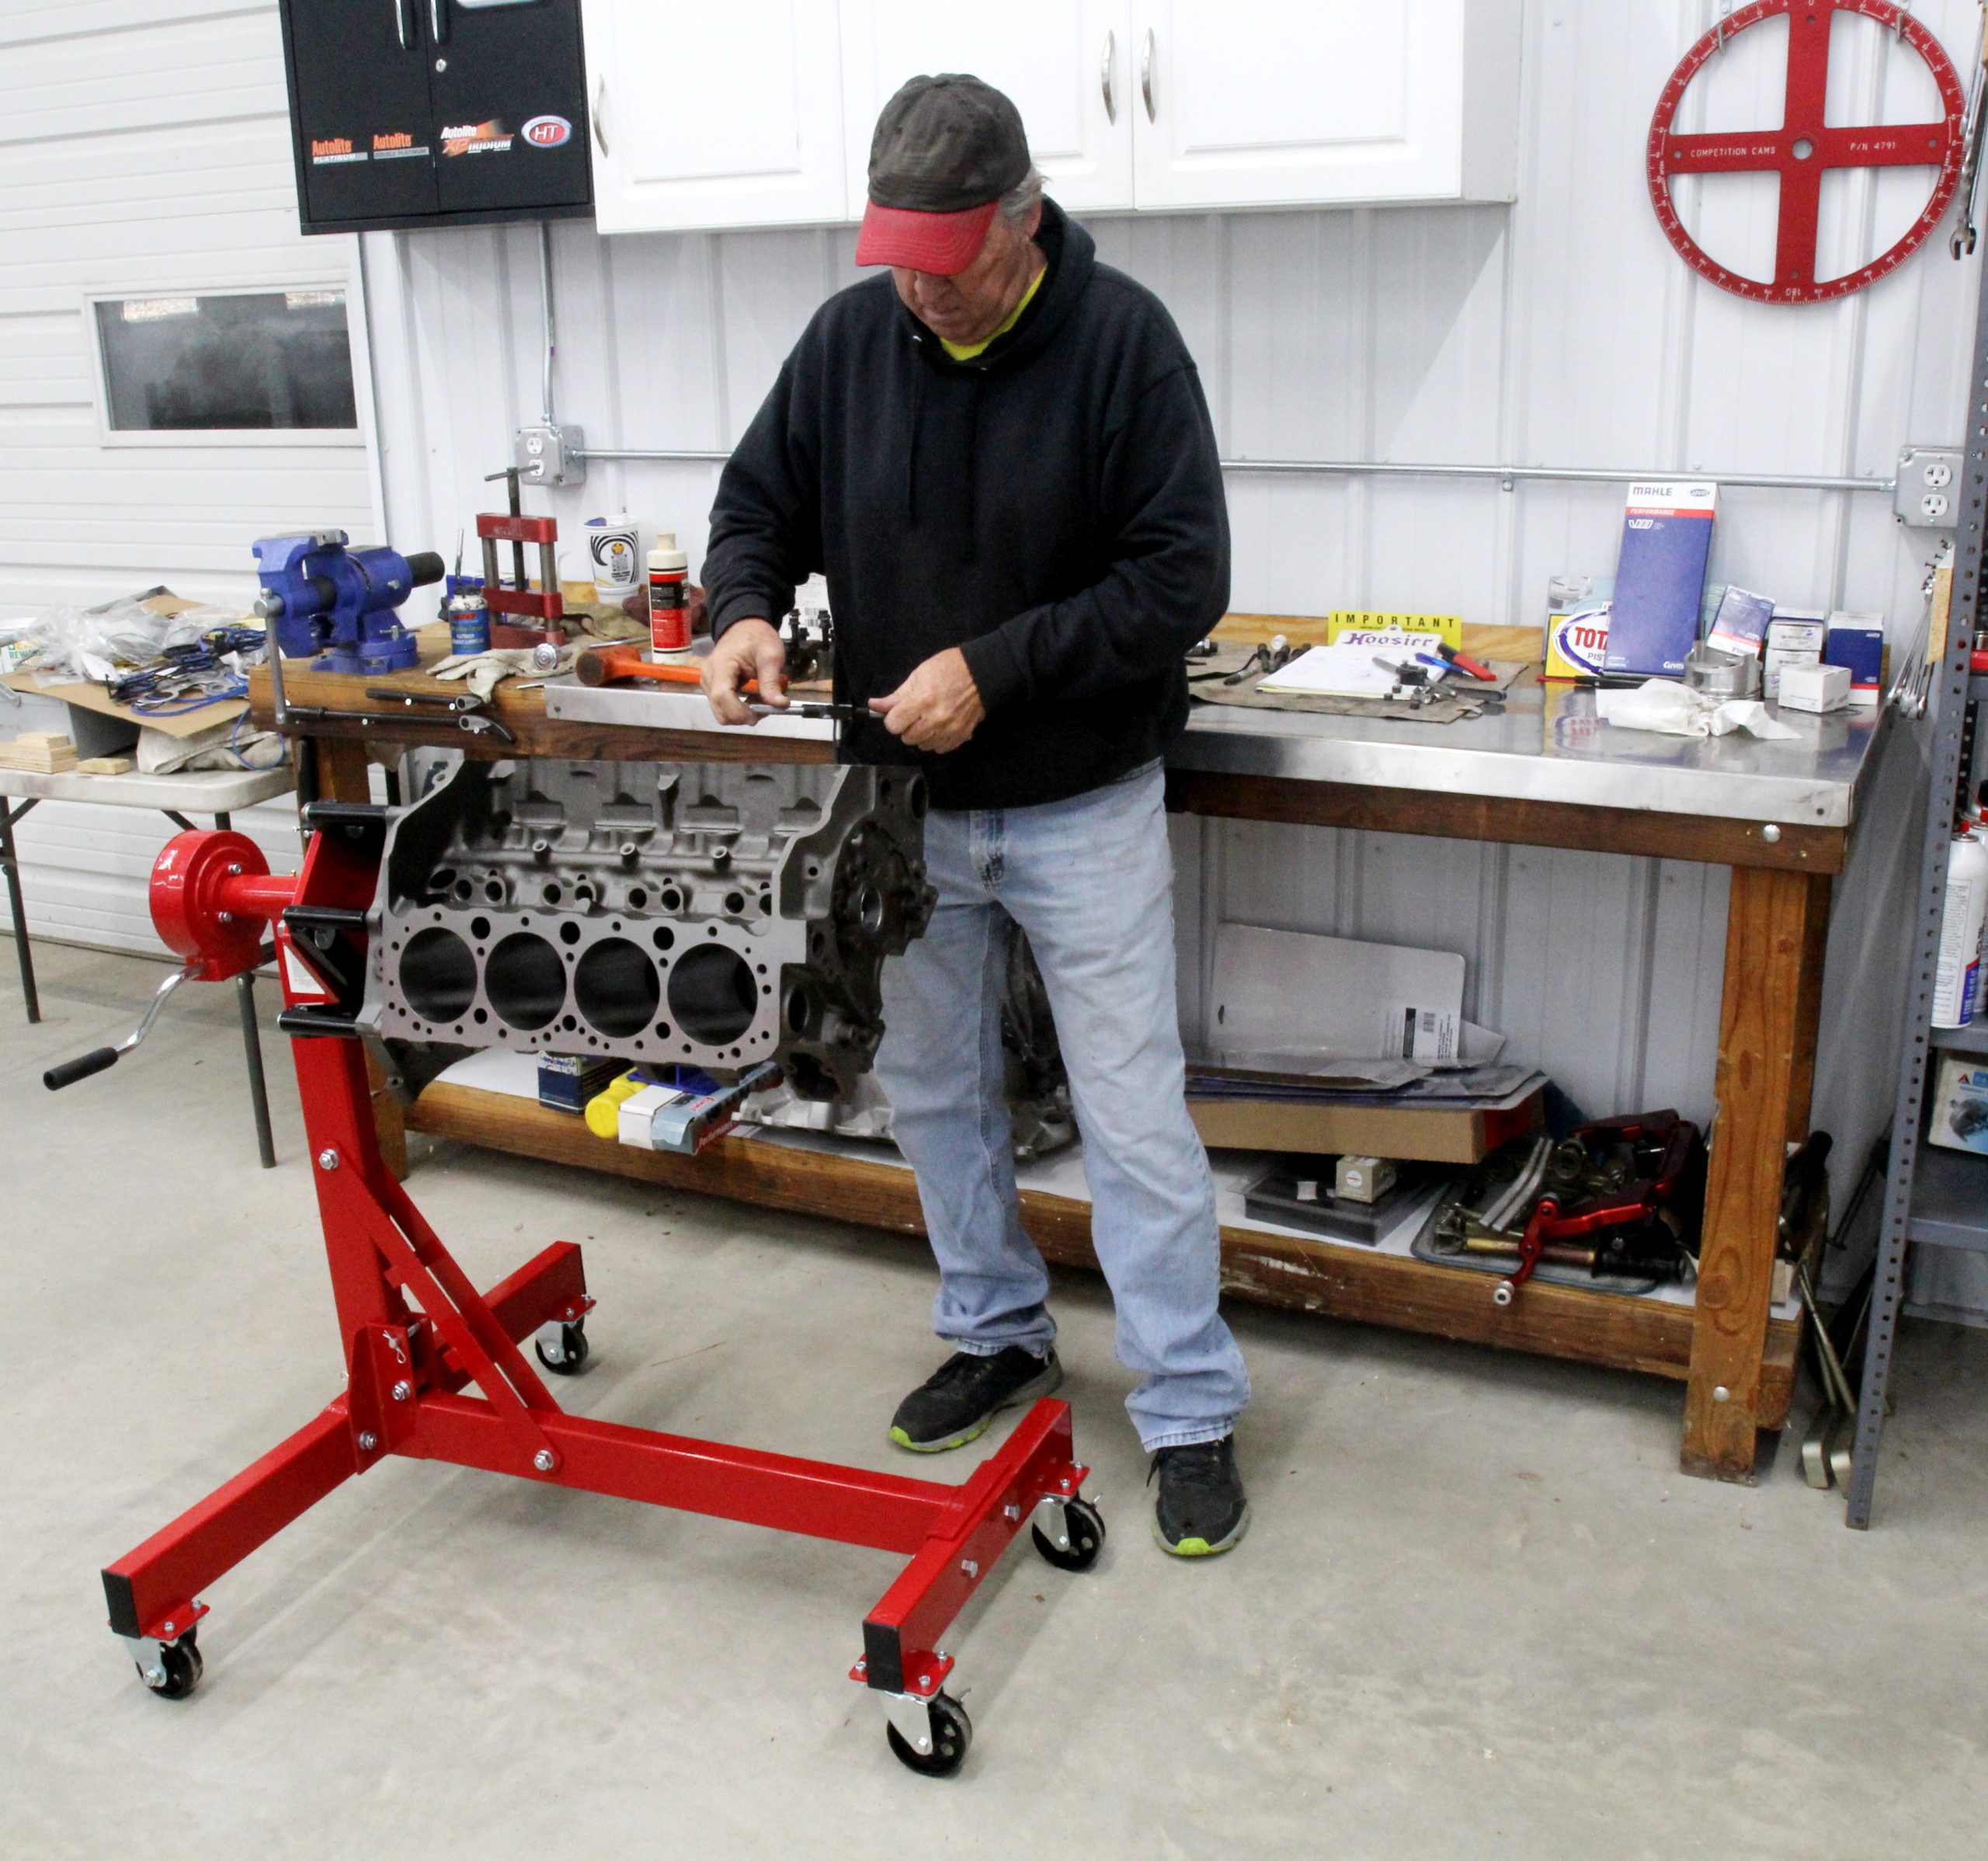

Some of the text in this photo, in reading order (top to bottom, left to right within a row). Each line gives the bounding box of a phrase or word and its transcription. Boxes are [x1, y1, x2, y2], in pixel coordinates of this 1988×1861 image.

[441, 124, 478, 139] Autolite
[534, 125, 559, 141] HT
[312, 137, 353, 156] Autolite
[373, 132, 412, 150] Autolite
[467, 138, 512, 151] IRIDIUM
[1850, 141, 1896, 151] P/N 4791
[1691, 147, 1777, 157] COMPETITION CAMS
[313, 155, 356, 165] PLATINUM
[1632, 486, 1673, 496] MAHLE
[1335, 614, 1455, 628] IMPORTANT
